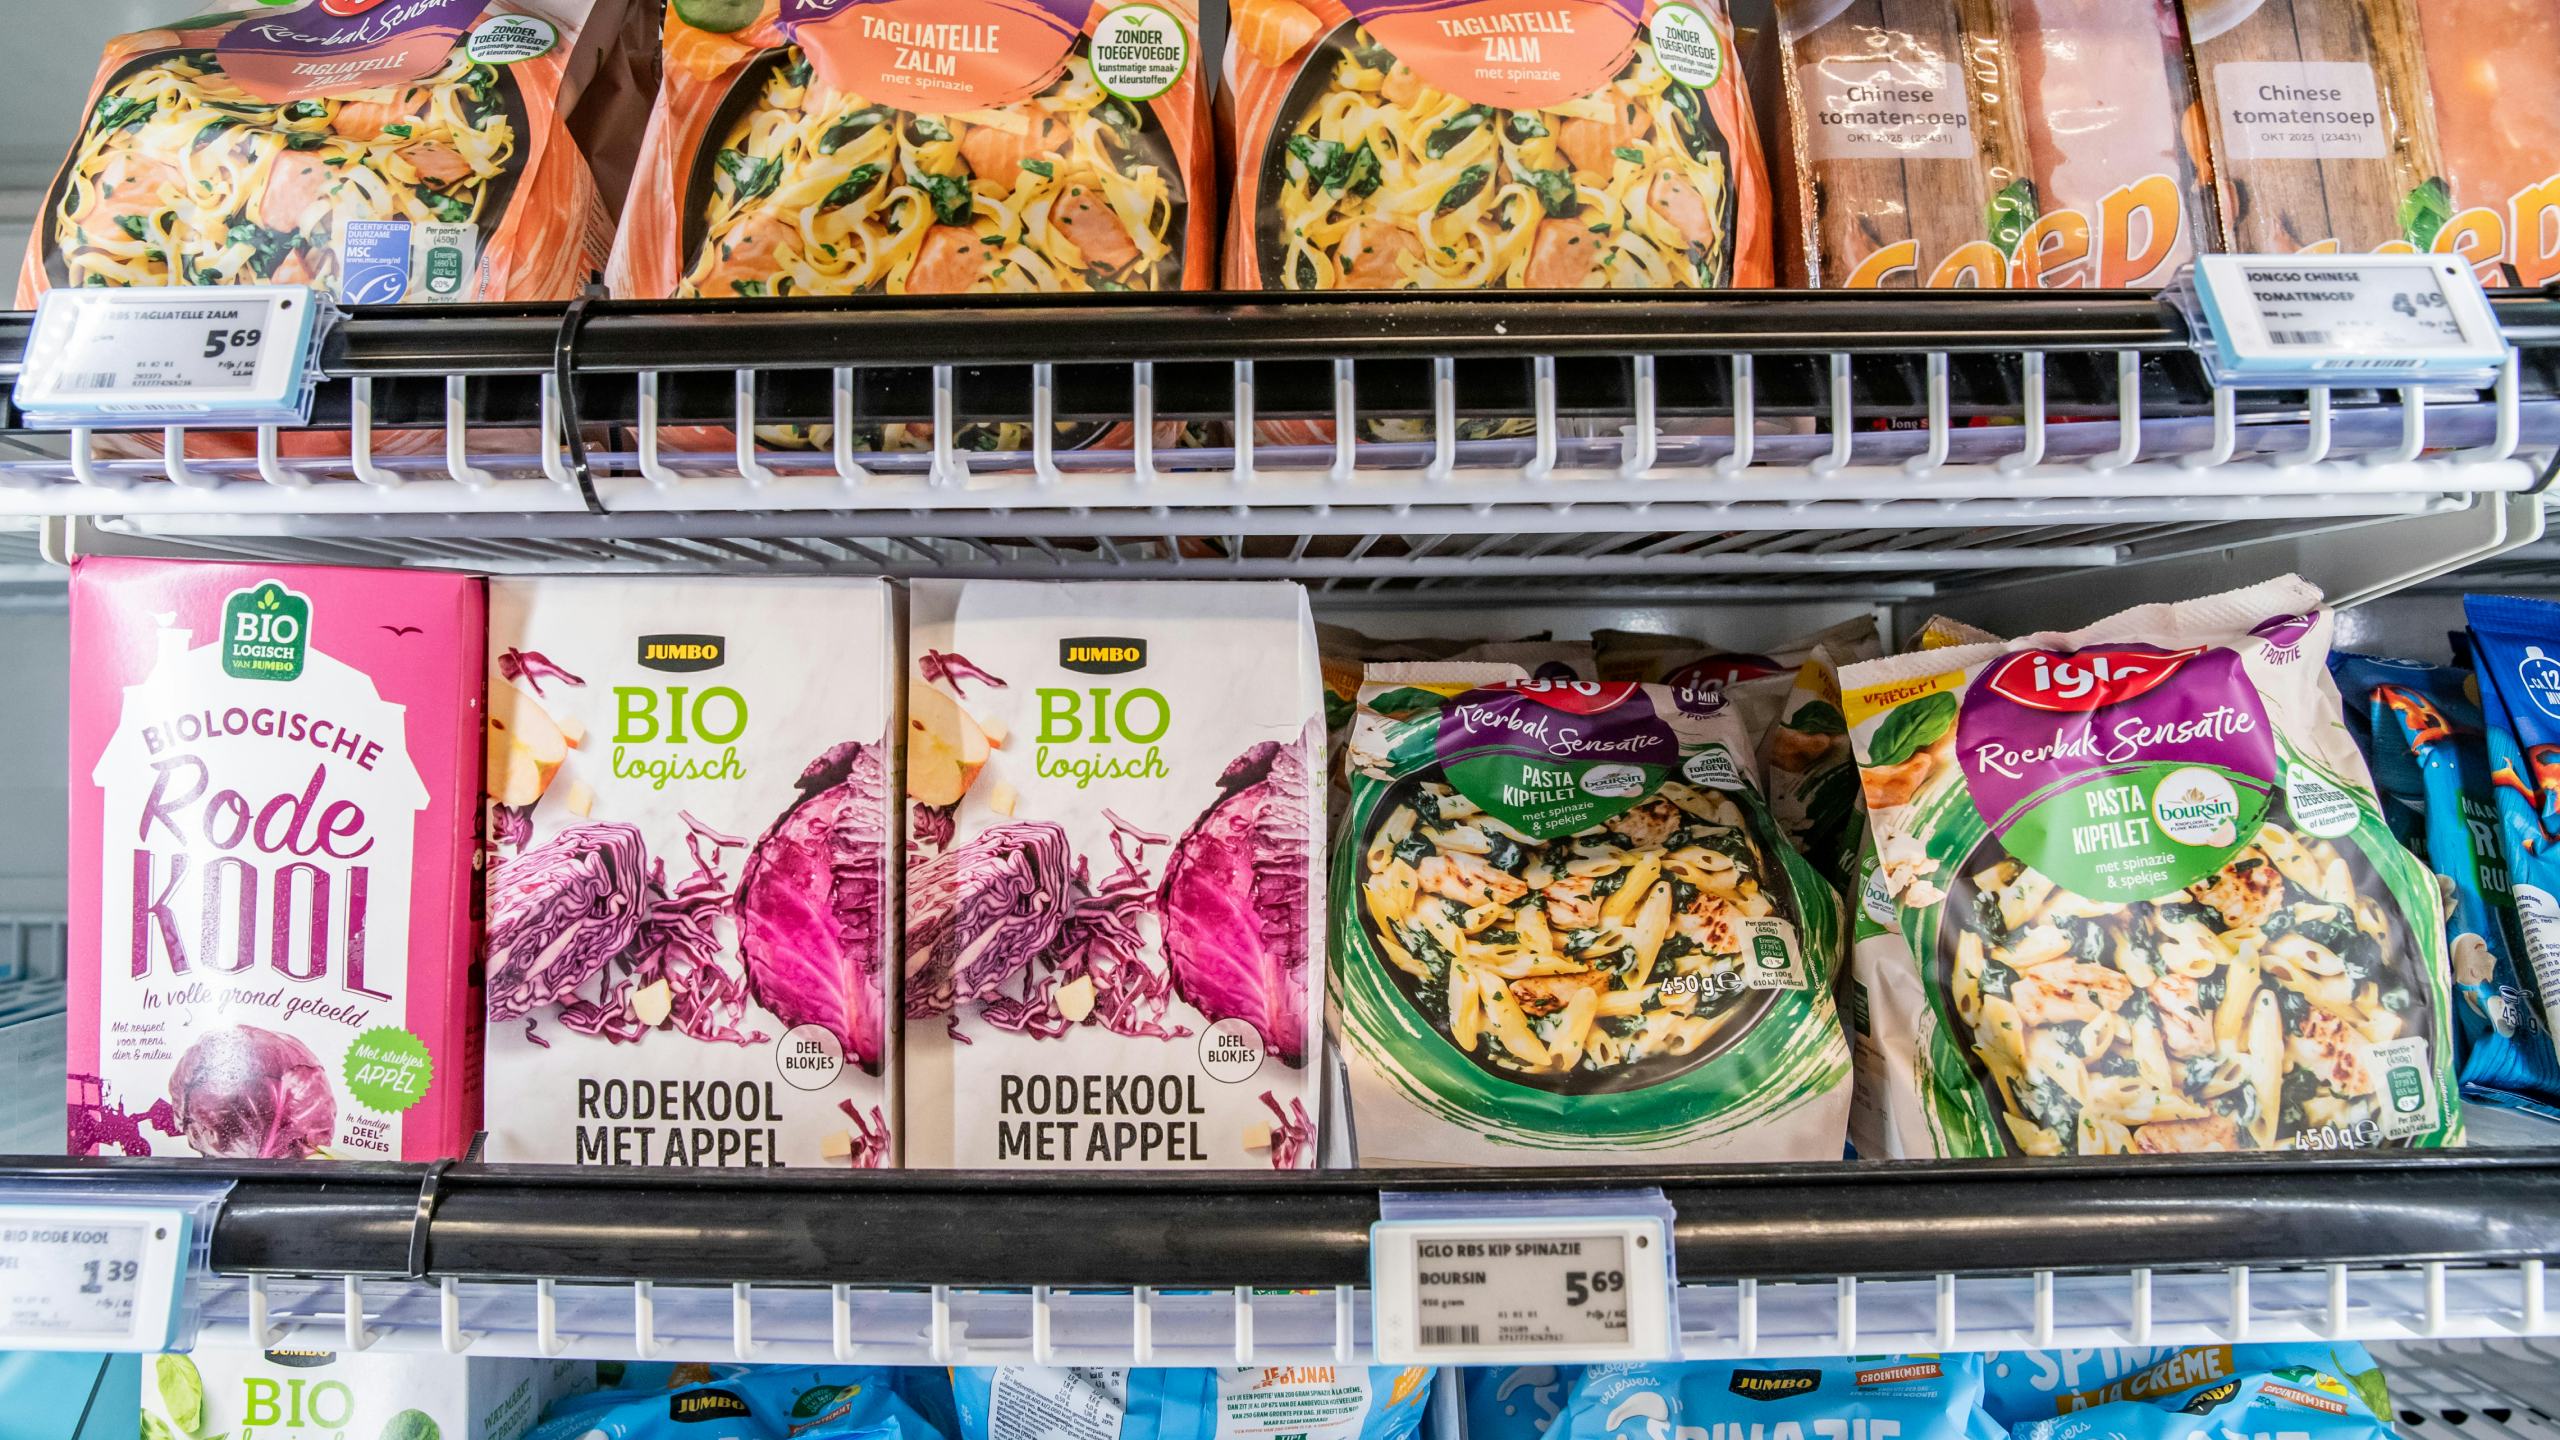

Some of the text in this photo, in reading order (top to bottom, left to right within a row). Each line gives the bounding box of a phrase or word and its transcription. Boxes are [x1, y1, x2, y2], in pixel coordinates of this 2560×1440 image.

[251, 0, 449, 46] Roerbak Sensa
[492, 26, 537, 37] ZONDER
[1437, 10, 1575, 37] TAGLIATELLE
[474, 34, 550, 47] TOEGEVOEGDE
[861, 16, 1000, 53] TAGLIATELLE
[1115, 30, 1162, 44] ZONDER
[1665, 26, 1700, 44] ZONDER
[1097, 46, 1180, 60] TOEGEVOEGDE
[1481, 37, 1541, 63] ZALM
[1656, 36, 1716, 60] TOEGEVOEGDE
[291, 51, 409, 75] TAGLIATELLE
[894, 47, 956, 76] ZALM
[1099, 63, 1178, 73] kunstmatige smaak-
[308, 72, 357, 89] ZALM
[881, 73, 974, 92] met spinazie
[1109, 75, 1167, 84] of kleurstoffen
[1475, 68, 1561, 83] met spinazie
[1847, 87, 1934, 103] Chinese
[2259, 86, 2342, 101] Chinese
[1819, 109, 1967, 129] tomatensoep
[2232, 108, 2375, 128] tomatensoep
[1847, 134, 1903, 144] OKT 2025
[2261, 132, 2362, 143] OKT 2025 (23431)
[348, 222, 410, 232] GECERTIFICEERD
[348, 231, 391, 239] DUURZAME
[425, 226, 461, 236] Per portie
[347, 238, 378, 246] VISSERIJ
[433, 236, 458, 246] (450g)
[346, 247, 371, 258] MSC
[346, 257, 401, 265] www.msc.org/nl
[434, 251, 458, 261] Energie
[444, 268, 457, 276] kcal
[2247, 272, 2360, 283] JONGSO CHINESE
[434, 280, 450, 288] 20%
[2254, 292, 2355, 302] TOMATENSOEP
[134, 310, 238, 320] TAGLIATELLE ZALM
[1891, 418, 1918, 430] Jong
[235, 613, 299, 644] BIO
[233, 645, 294, 660] LOGISCH
[645, 644, 718, 660] JUMBO
[1067, 647, 1140, 662] JUMBO
[2264, 645, 2301, 665] PORTIE
[232, 660, 294, 672] VAN JUMBO
[1506, 677, 1601, 696] go
[1698, 691, 1719, 703] MIN
[612, 686, 748, 744] BIO
[1035, 687, 1171, 745] BIO
[142, 707, 384, 772] BIOLOGISCHE
[1549, 728, 1663, 756] Sensatie
[1975, 705, 2256, 780] Roerbak Sensatie
[612, 745, 747, 791] logisch
[1036, 745, 1169, 790] logisch
[1522, 765, 1574, 789] PASTA
[1584, 773, 1641, 788] boursin
[1503, 785, 1575, 807] KIPFILET
[2085, 785, 2147, 819] PASTA
[139, 753, 375, 859] Rode
[1522, 801, 1594, 822] met spinazie
[2159, 799, 2232, 821] boursin
[2298, 805, 2337, 819] kunstmatige
[1532, 813, 1587, 831] & spekjes
[2310, 812, 2357, 828] of kleurstoffen
[2072, 817, 2150, 855] KIPFILET
[2096, 852, 2176, 875] met spinazie
[2107, 869, 2168, 891] & spekjes
[131, 849, 393, 1003] KOOL
[1757, 920, 1778, 928] portie
[1661, 975, 1716, 996] 450 g
[142, 983, 369, 1029] In volle grond geteeld
[112, 1021, 165, 1036] Met respect
[116, 1038, 137, 1047] voor
[796, 1041, 824, 1055] DEEL
[1218, 1035, 1246, 1048] DEEL
[112, 1049, 173, 1061] dier & milieu
[355, 1044, 425, 1073] Met stukjes
[786, 1056, 834, 1071] BLOKJES
[1208, 1049, 1255, 1064] BLOKJES
[354, 1063, 416, 1094] APPEL
[578, 1078, 783, 1123] RODEKOOL
[999, 1075, 1205, 1116] RODEKOOL
[345, 1113, 391, 1133] In handige
[352, 1126, 383, 1140] DEEL-
[999, 1121, 1207, 1162] MET APPEL
[2295, 1125, 2339, 1150] 450
[342, 1135, 390, 1152] BLOKJES
[576, 1125, 786, 1168] MET APPEL
[4, 1230, 109, 1244] BIO RODE KOOL
[1419, 1243, 1582, 1258] IGLO RBS KIP SPINAZIE
[1420, 1272, 1487, 1285] BOURSIN
[1442, 1299, 1464, 1309] gram
[1860, 1365, 1937, 1384] GROENTE(M)ETER
[1600, 1377, 1661, 1405] vriesvers
[1739, 1377, 1813, 1391] JUMBO
[242, 1377, 355, 1428] BIO
[677, 1397, 746, 1414] JUMBO
